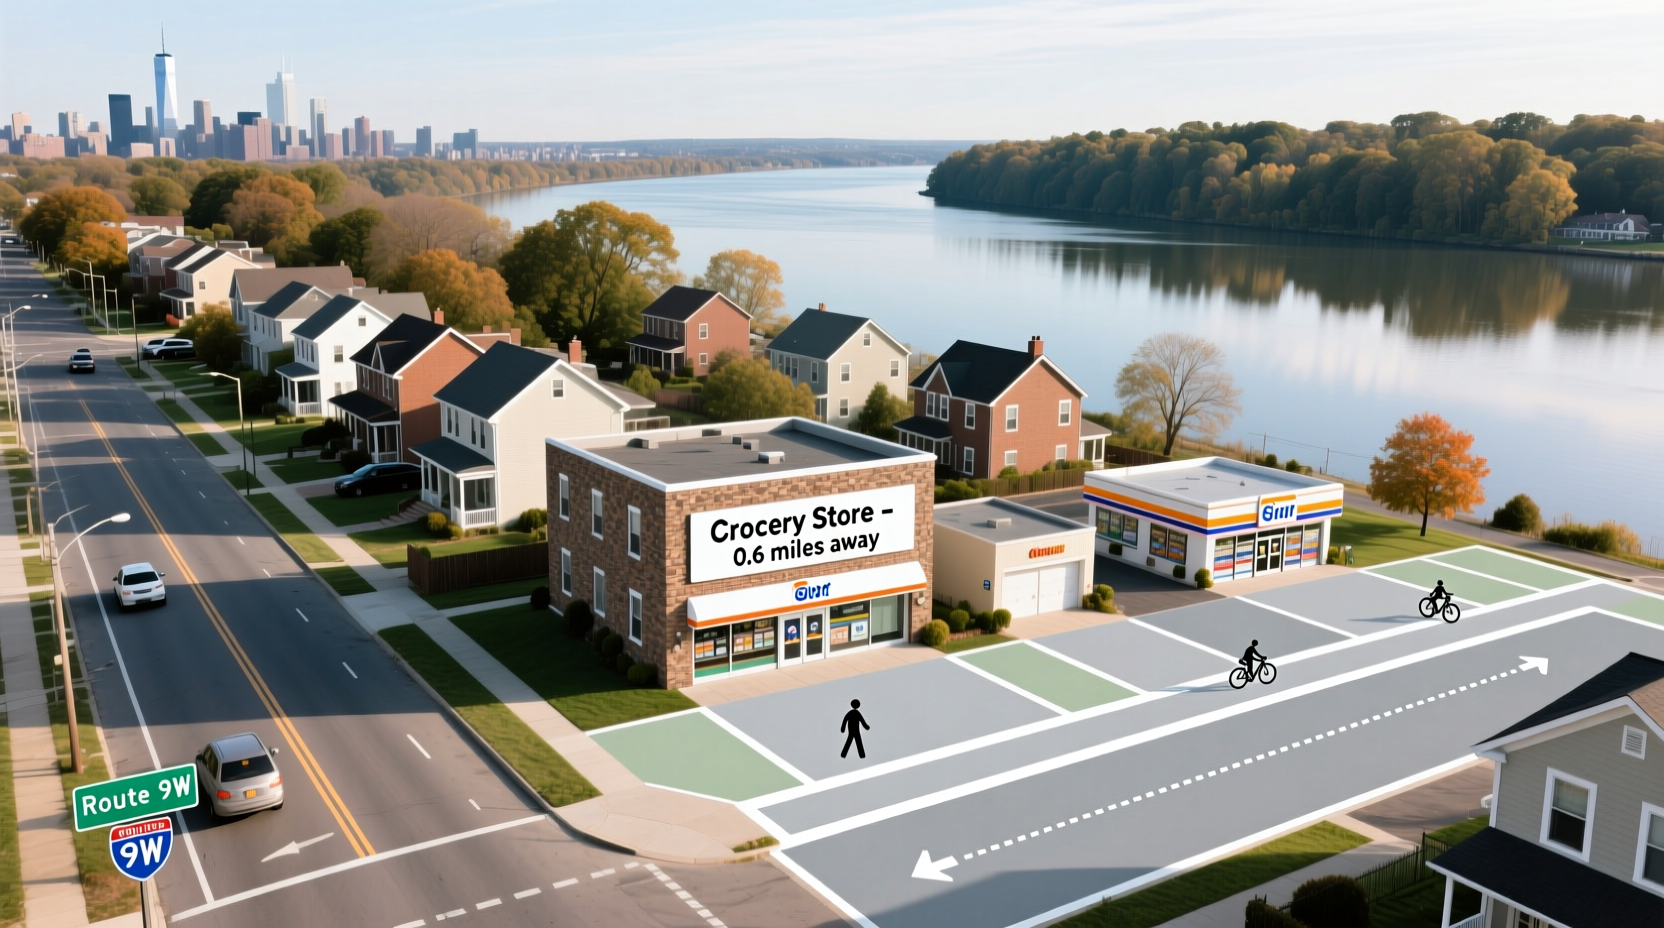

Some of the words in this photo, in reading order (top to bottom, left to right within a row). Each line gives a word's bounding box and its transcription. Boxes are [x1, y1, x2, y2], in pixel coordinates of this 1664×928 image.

[710, 513, 806, 543] Crocery
[812, 506, 874, 529] Store
[733, 545, 765, 567] 0.6
[771, 538, 825, 561] miles
[830, 532, 880, 552] away
[82, 788, 150, 816] Route
[158, 774, 191, 800] 9W
[120, 835, 163, 869] 9W
